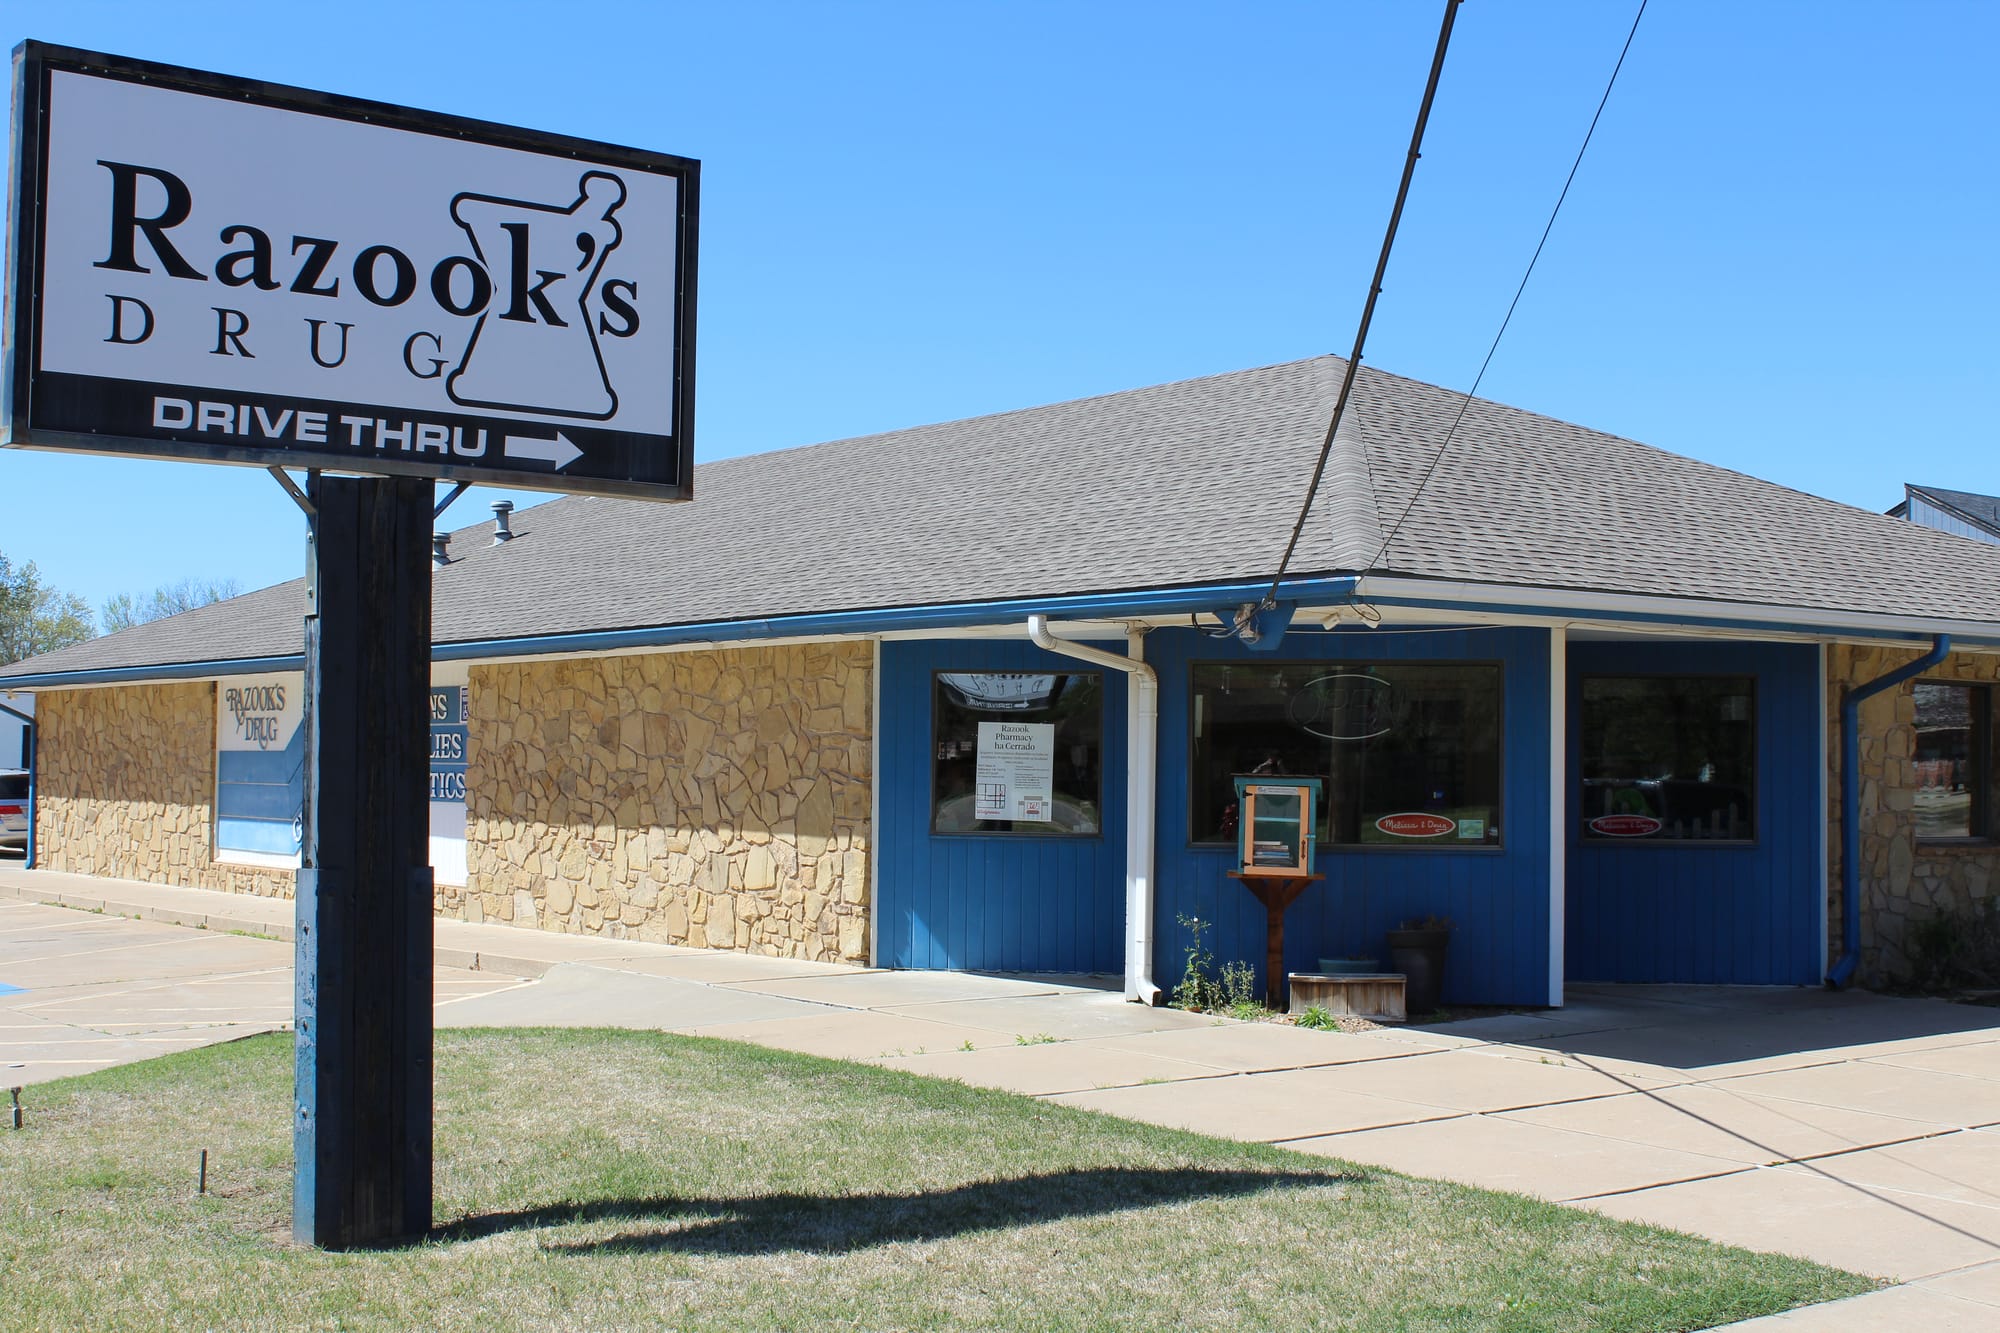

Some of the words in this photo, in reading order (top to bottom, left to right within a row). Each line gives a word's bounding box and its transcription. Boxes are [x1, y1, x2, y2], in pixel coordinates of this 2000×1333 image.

[93, 160, 640, 338] Razook's
[104, 294, 449, 379] DRUG
[153, 396, 328, 443] DRIVE
[340, 415, 487, 458] THRU
[226, 683, 286, 731] RAZOOK'S
[245, 717, 279, 750] DRUG
[995, 742, 1004, 750] ha
[1005, 742, 1035, 751] Cerrado
[996, 733, 1034, 742] Pharmacy
[1002, 724, 1030, 733] Razook
